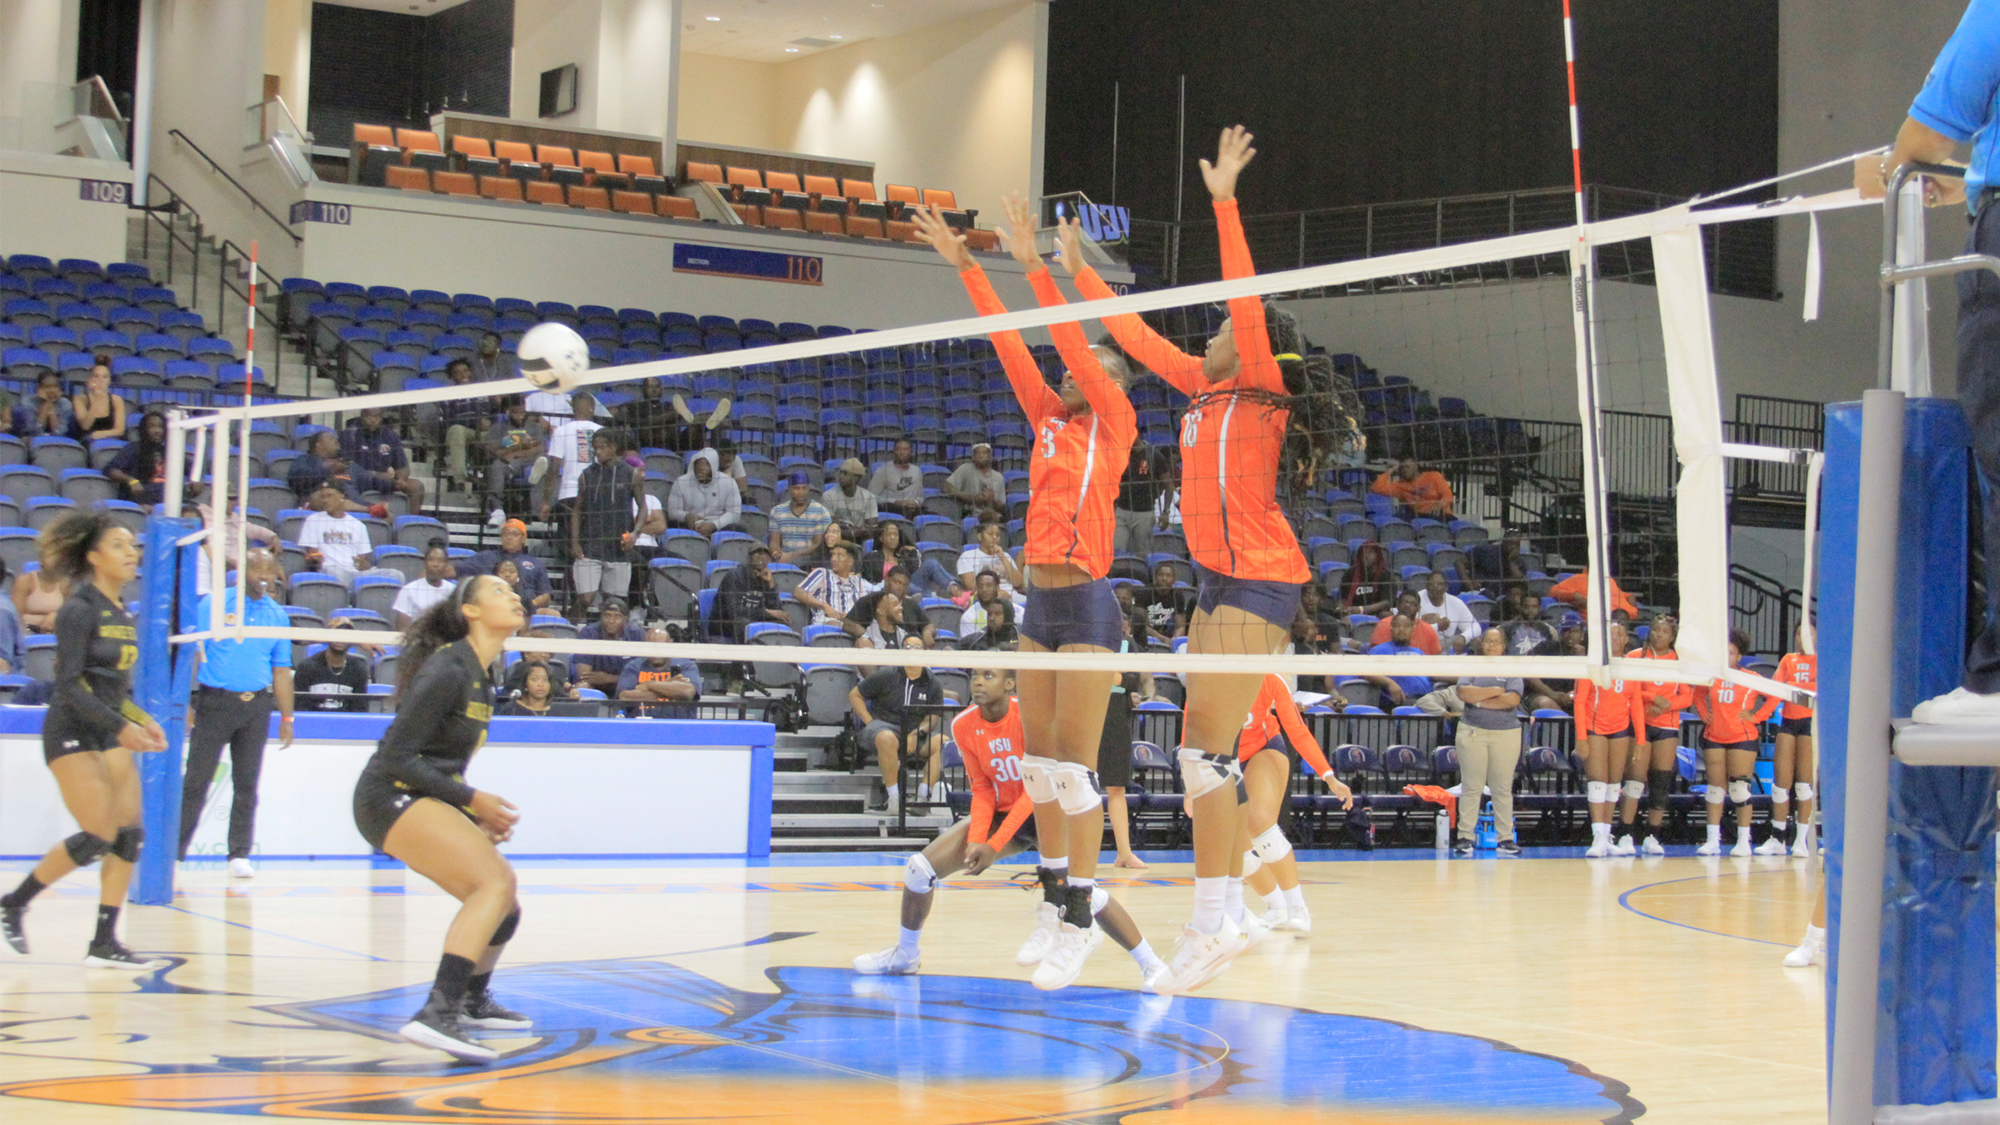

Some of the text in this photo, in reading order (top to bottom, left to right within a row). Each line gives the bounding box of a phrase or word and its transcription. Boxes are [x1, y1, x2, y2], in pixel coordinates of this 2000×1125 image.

[92, 182, 126, 203] 109
[321, 203, 349, 224] 110
[787, 256, 821, 282] 110
[1040, 426, 1057, 459] 3
[1793, 672, 1811, 684] 15
[1717, 689, 1735, 705] 10
[990, 755, 1022, 782] 30
